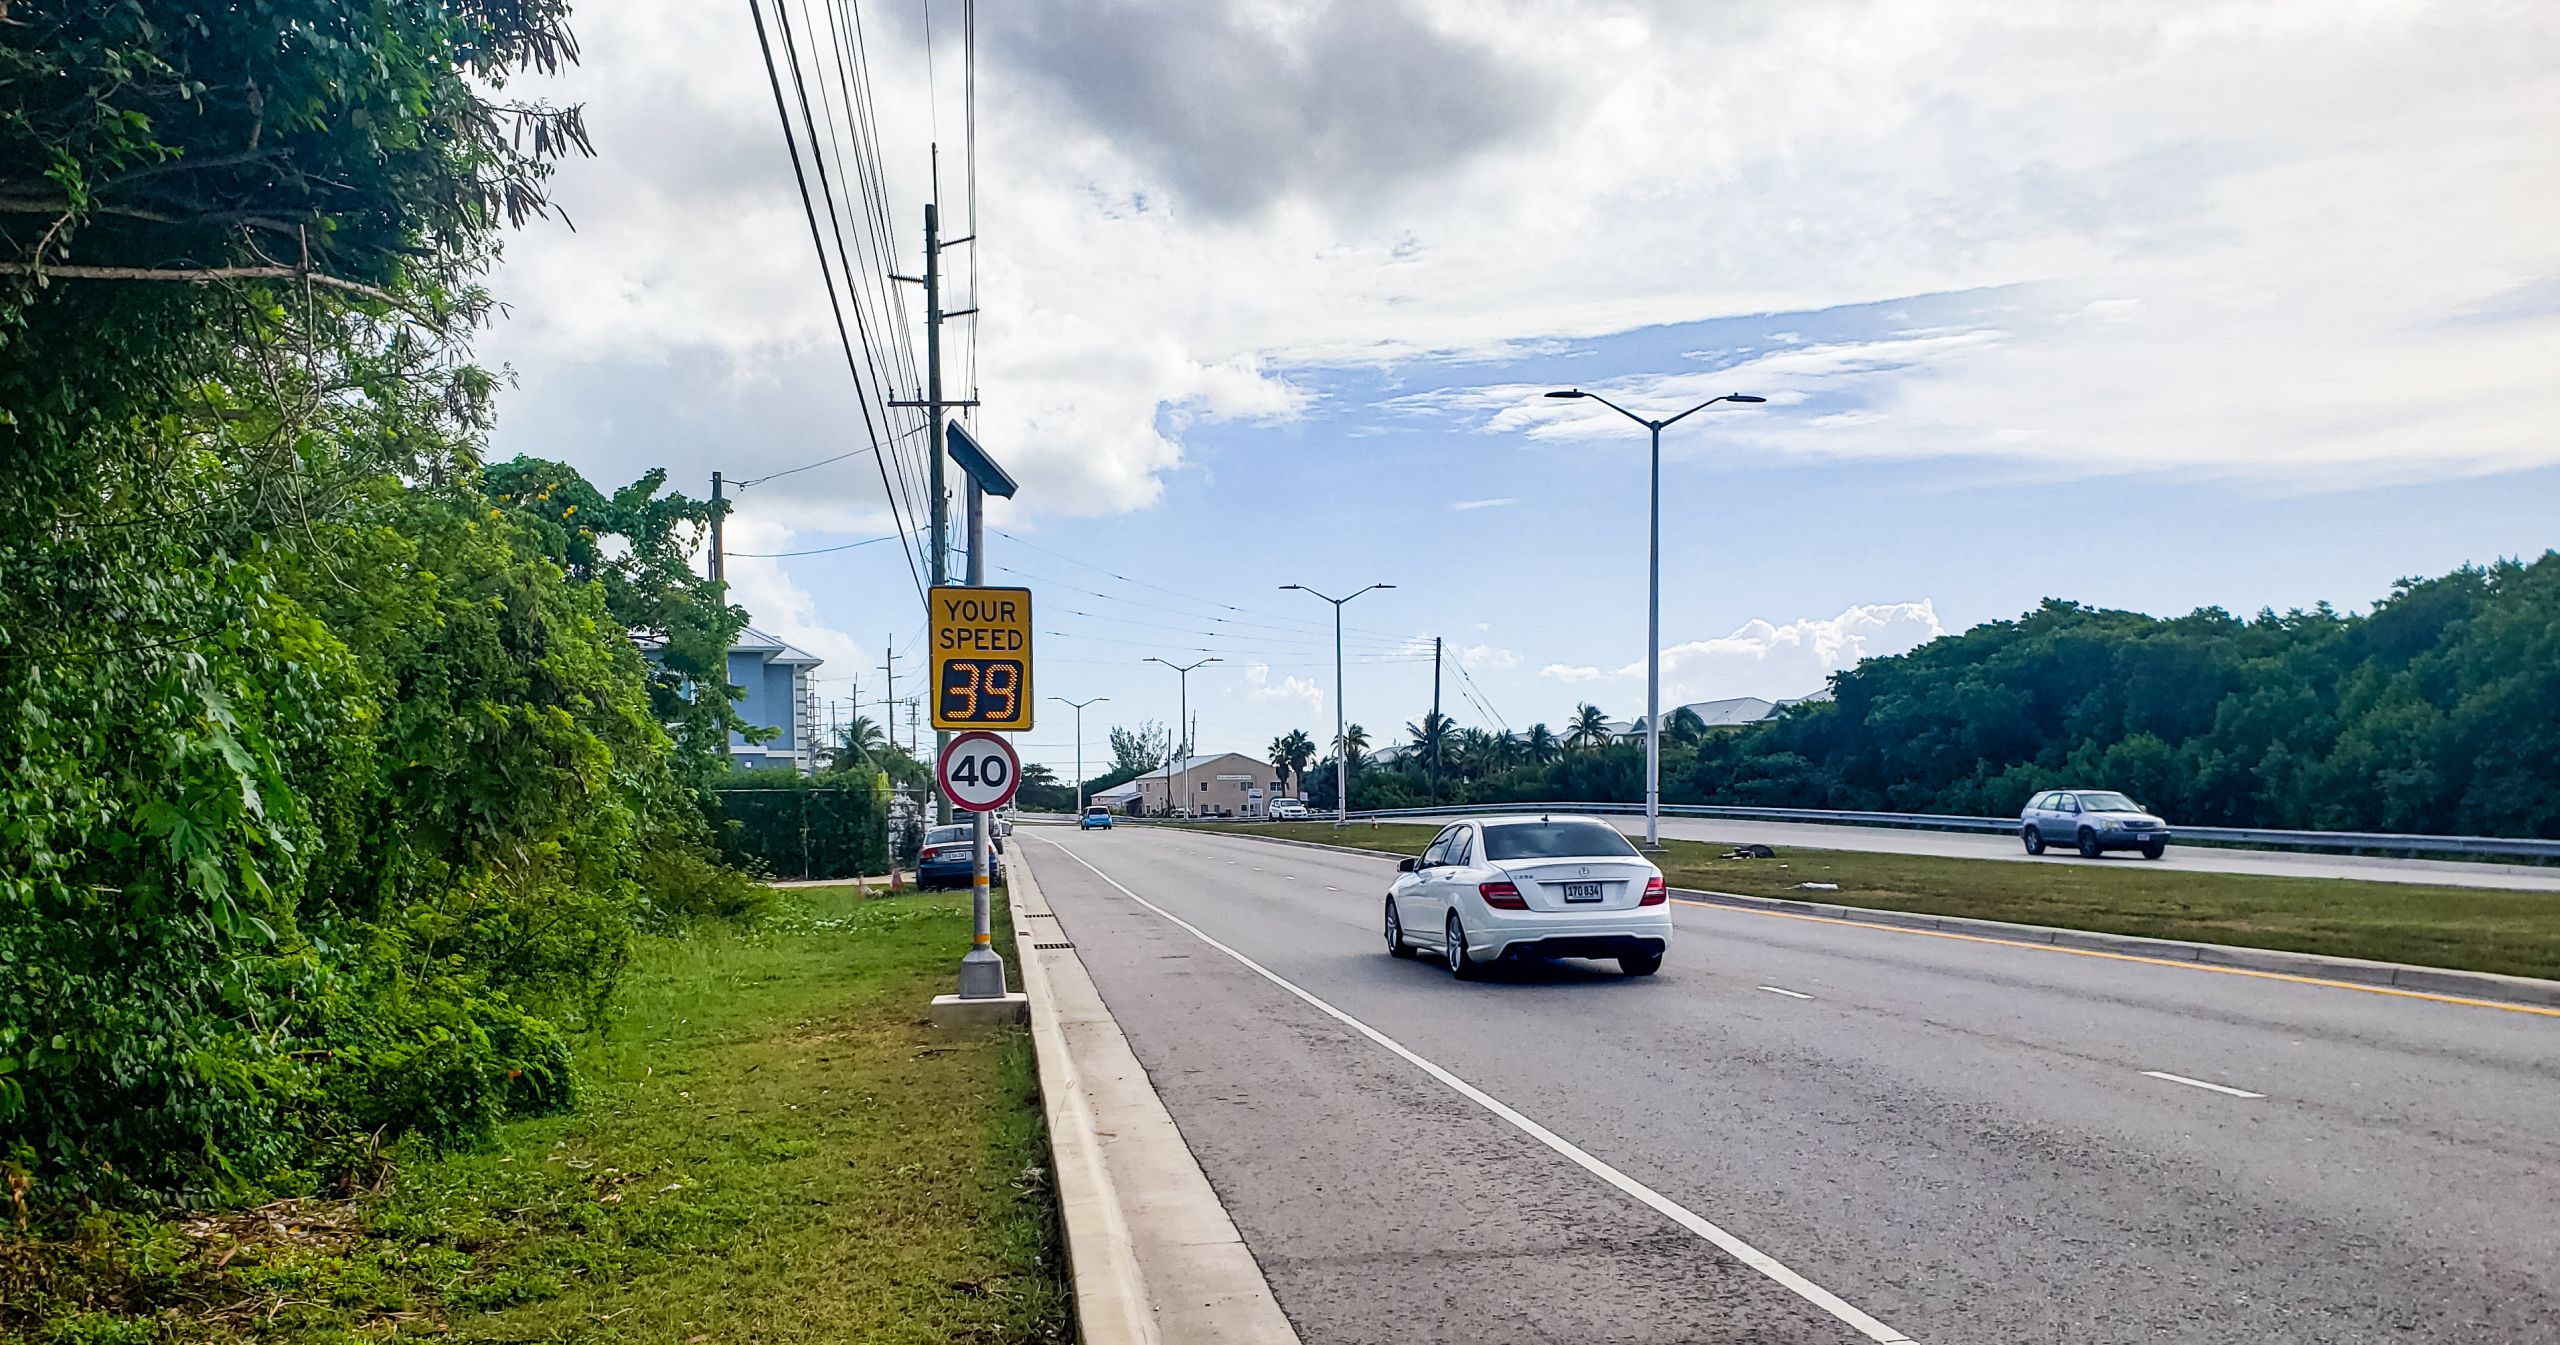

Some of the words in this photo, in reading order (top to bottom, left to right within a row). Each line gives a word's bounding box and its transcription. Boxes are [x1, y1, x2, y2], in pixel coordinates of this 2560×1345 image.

[943, 599, 1016, 623] YOUR
[939, 628, 1023, 650] SPEED
[946, 663, 1018, 719] 39
[951, 755, 1007, 787] 40
[1584, 885, 1599, 896] 834
